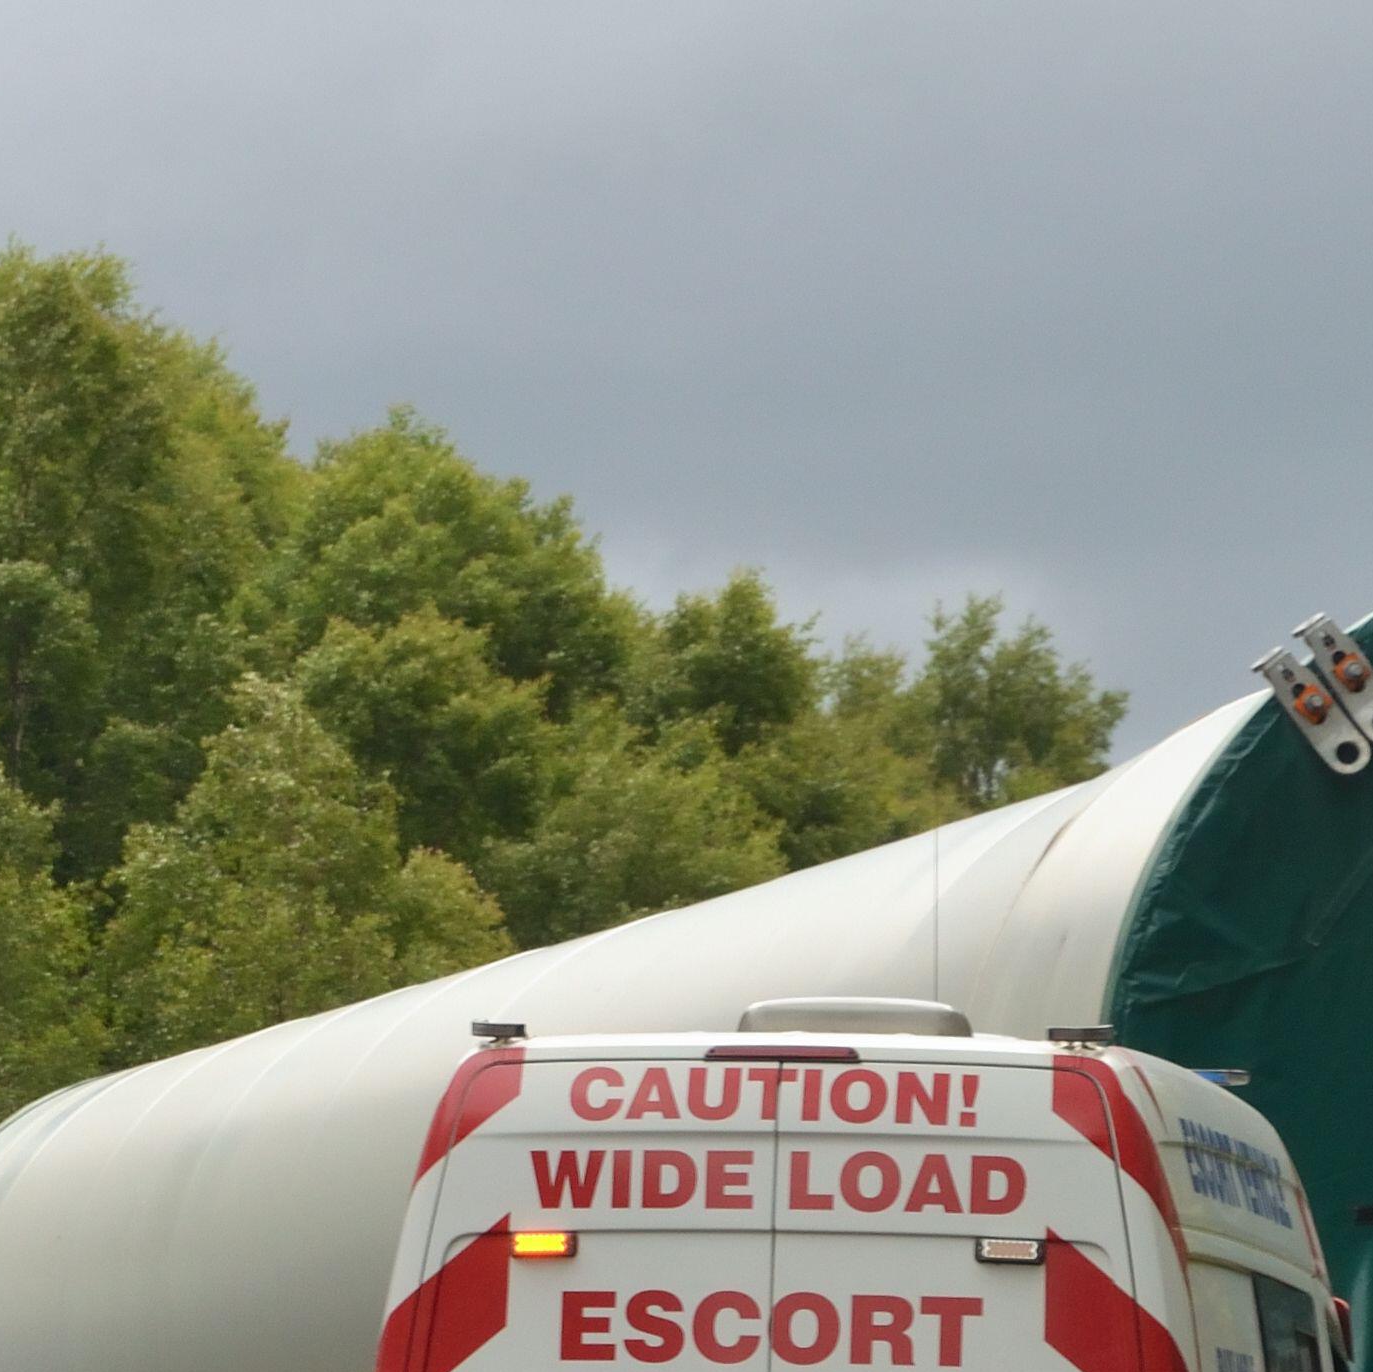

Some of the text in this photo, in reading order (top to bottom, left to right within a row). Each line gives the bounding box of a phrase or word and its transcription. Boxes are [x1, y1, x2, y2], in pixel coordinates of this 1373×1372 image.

[569, 1066, 981, 1128] CAUTION!
[530, 1149, 1028, 1216] WIDE LOAD
[559, 1289, 984, 1368] ESCORT
